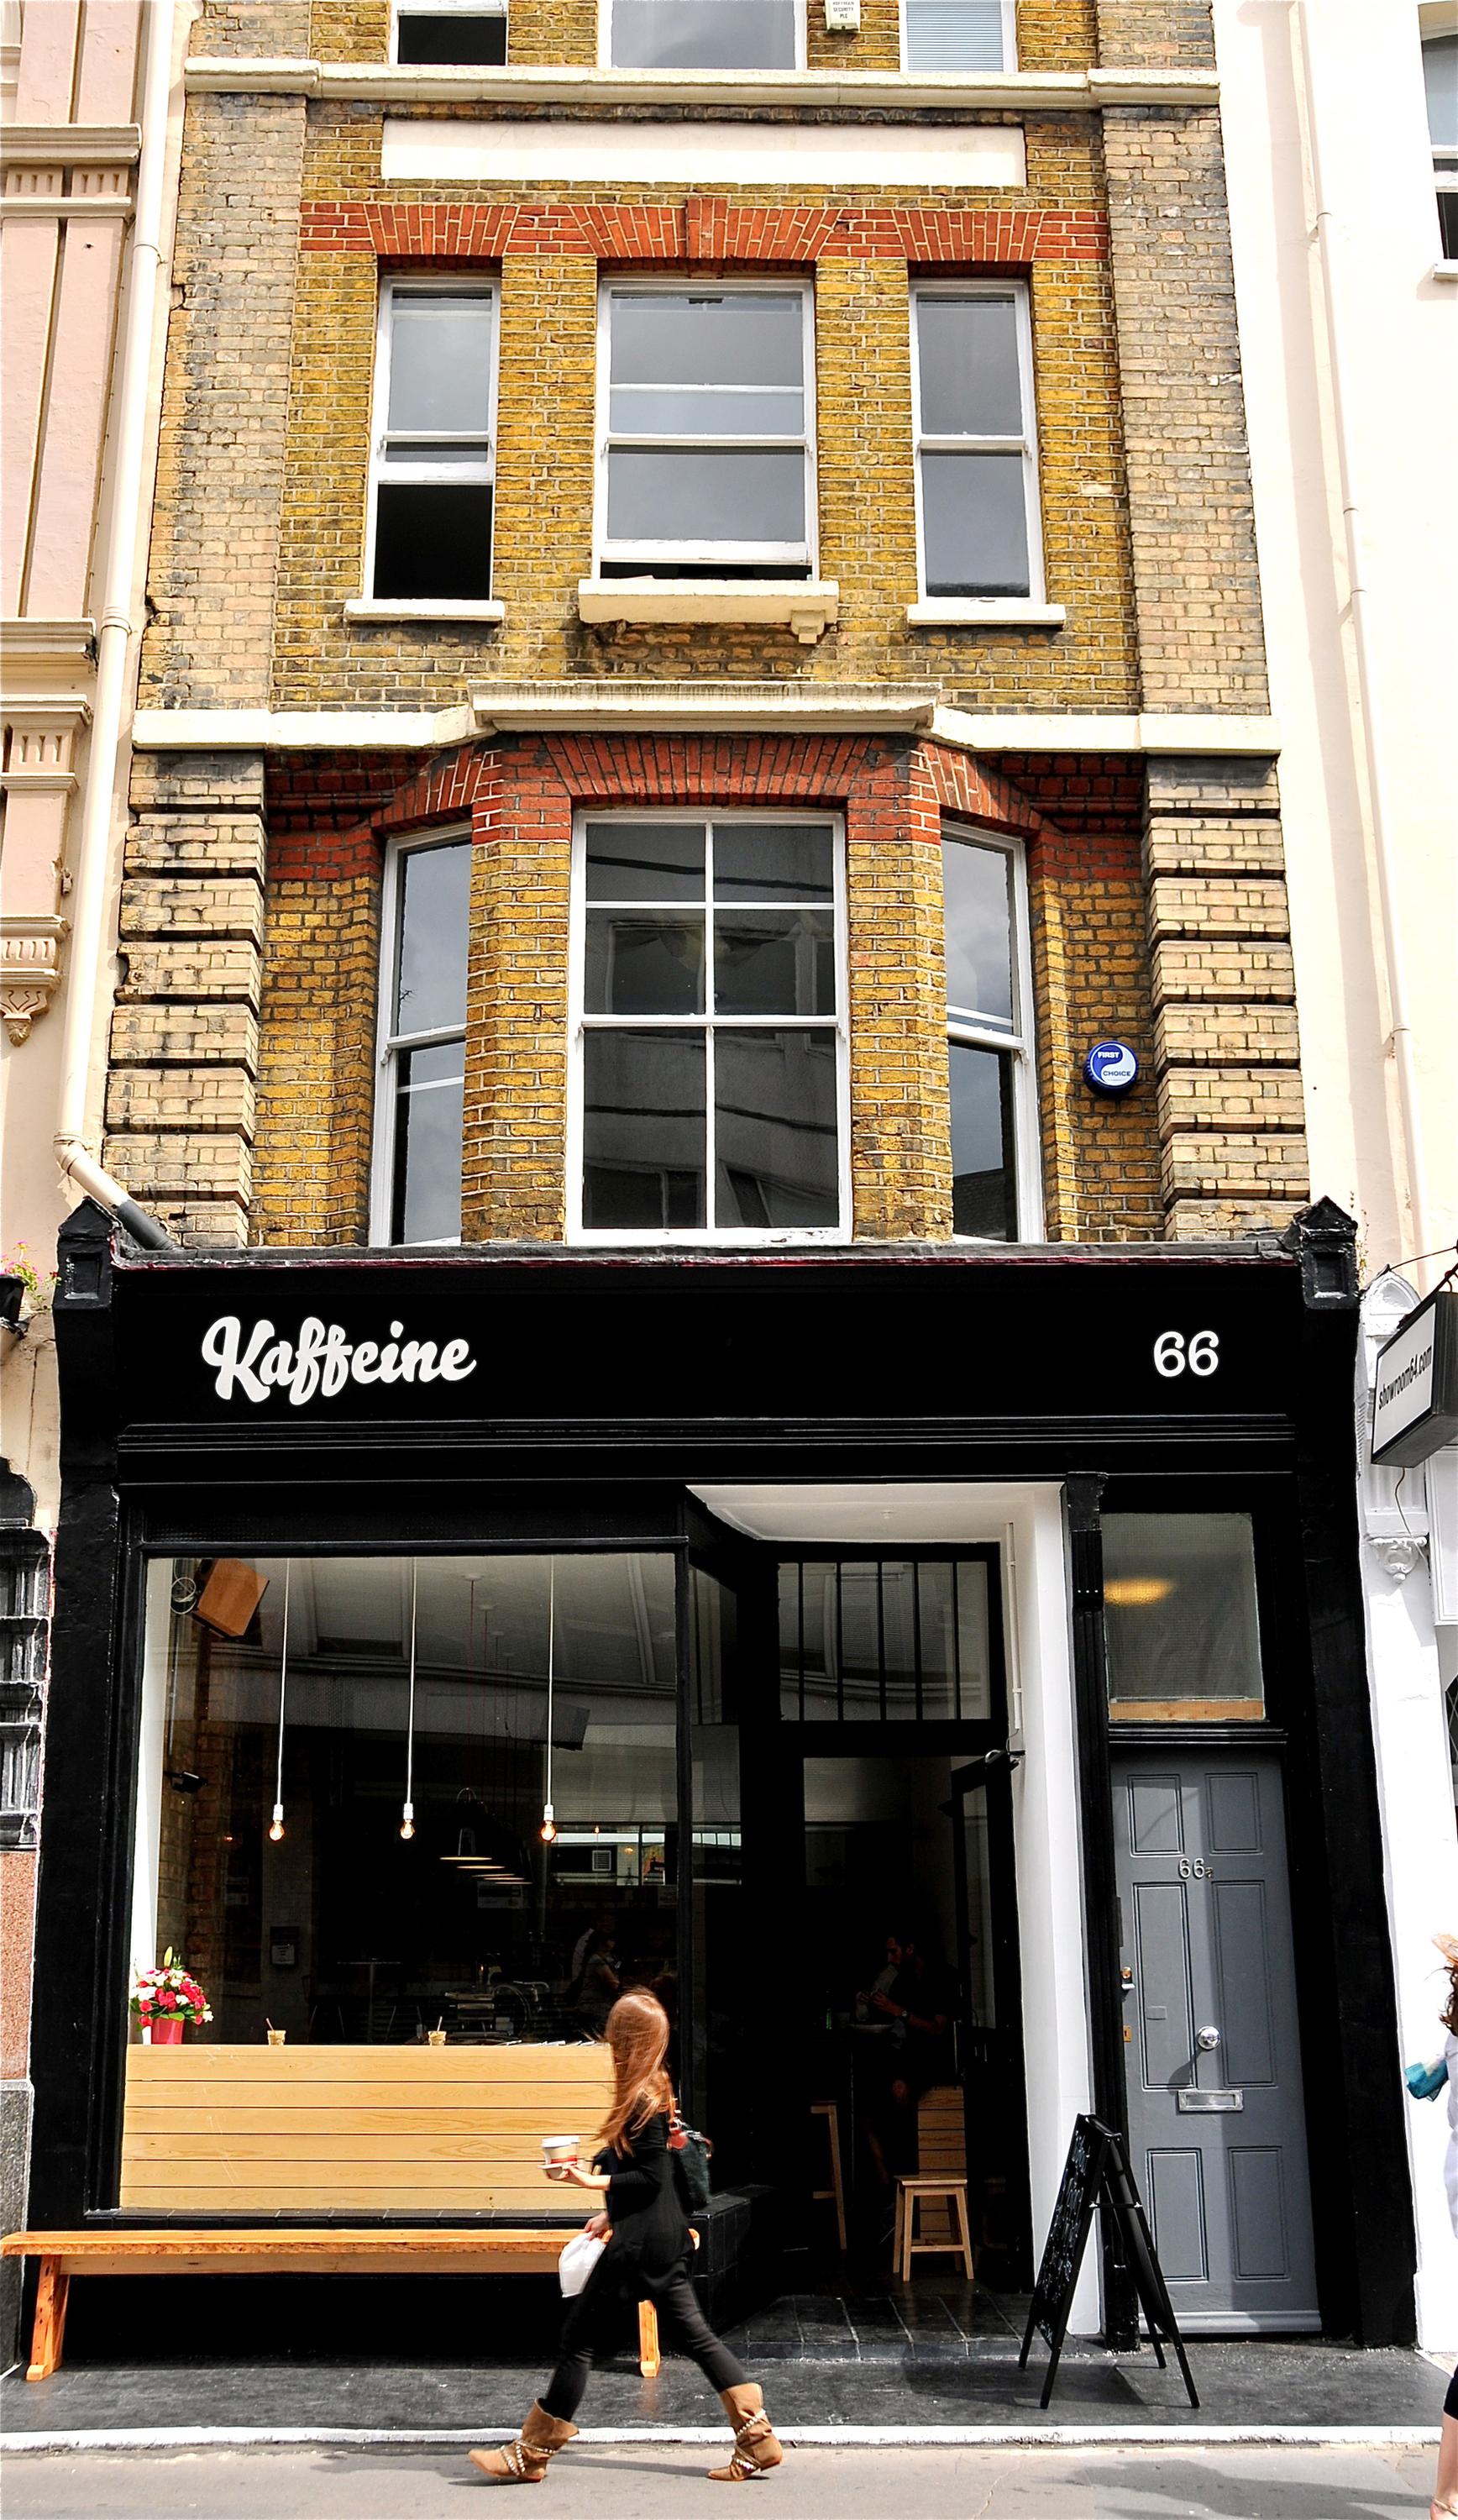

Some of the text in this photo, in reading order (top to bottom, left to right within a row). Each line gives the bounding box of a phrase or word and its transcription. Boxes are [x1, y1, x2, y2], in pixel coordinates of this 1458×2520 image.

[202, 1315, 477, 1406] Kaffeine
[1153, 1330, 1219, 1378] 66
[1378, 1345, 1433, 1410] showroom64.com
[1178, 1857, 1214, 1879] 66a
